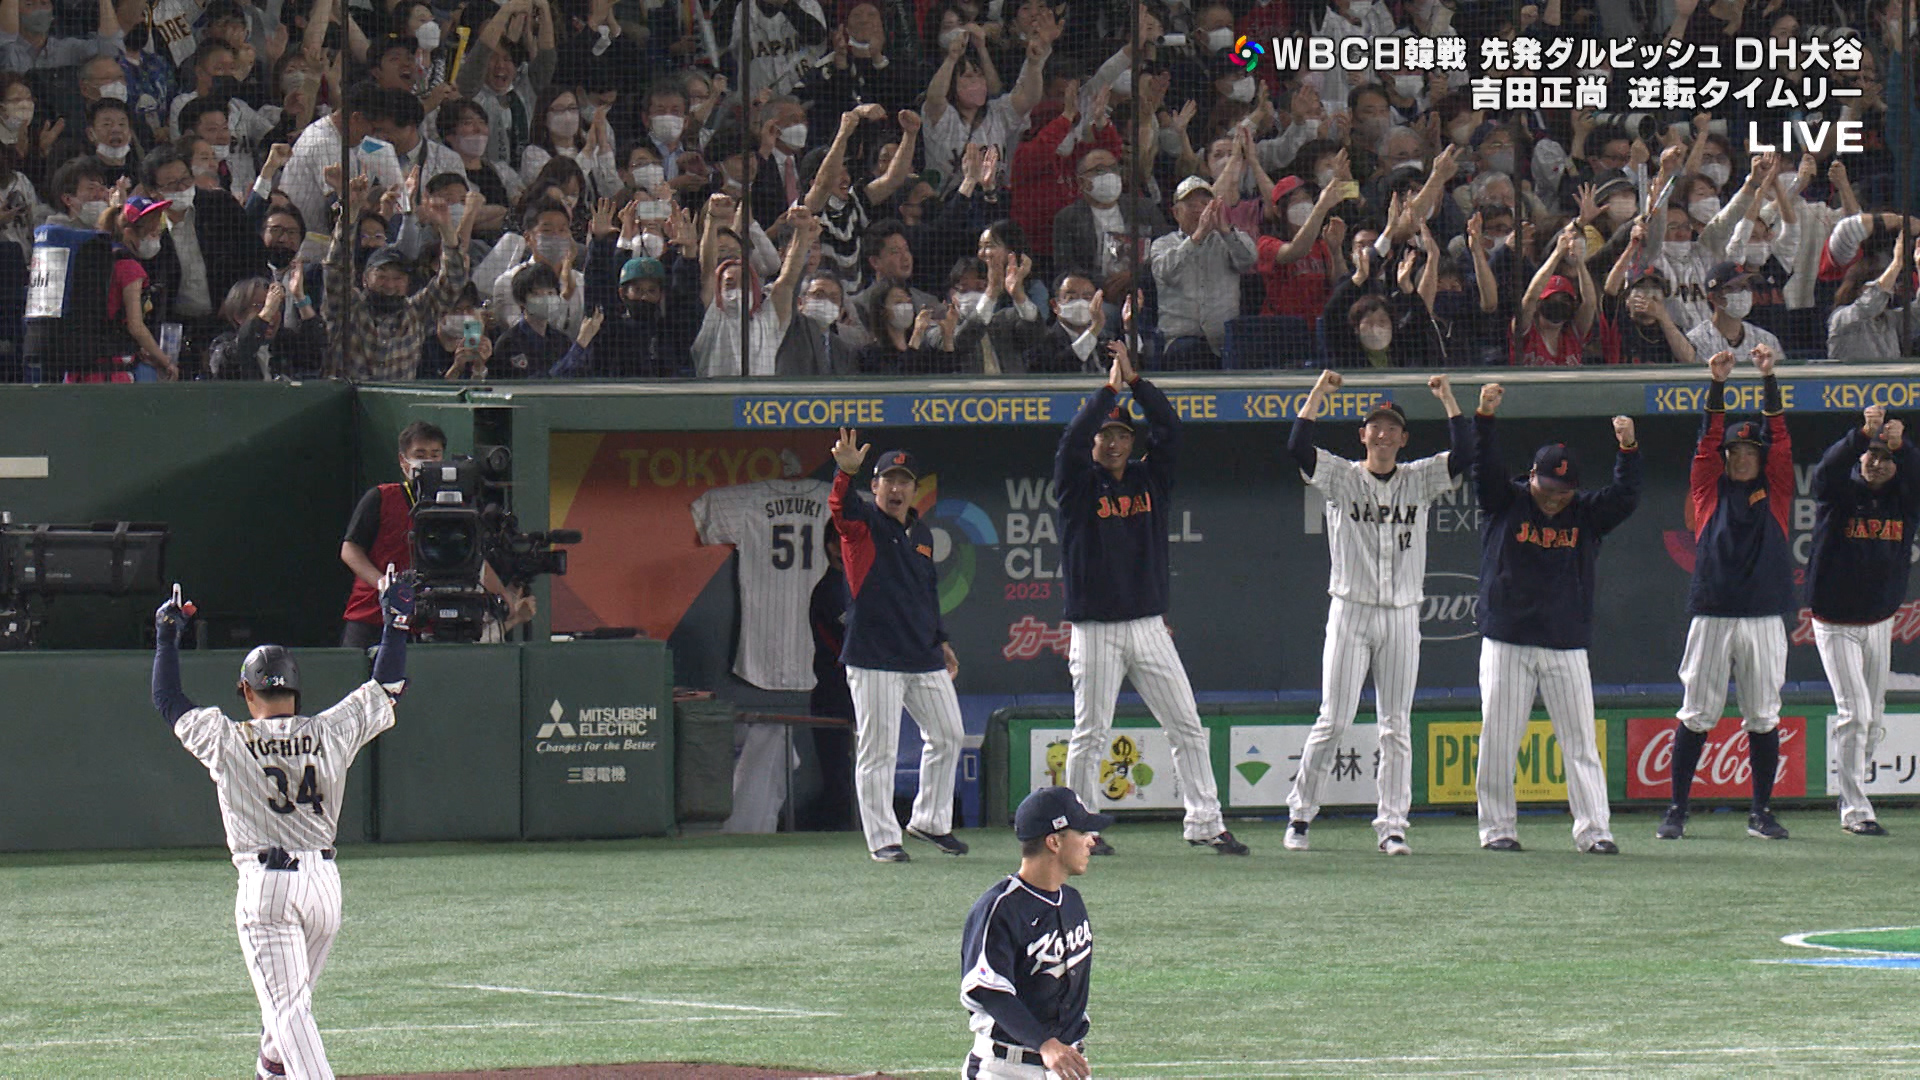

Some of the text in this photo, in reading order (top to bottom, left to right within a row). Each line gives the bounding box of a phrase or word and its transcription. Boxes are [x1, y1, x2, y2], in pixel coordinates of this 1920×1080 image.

[619, 448, 782, 488] TOKYO
[765, 499, 822, 518] SUZUKI
[771, 524, 814, 571] 51
[1005, 583, 1051, 600] 2023
[273, 676, 285, 686] 34
[580, 707, 657, 722] MITSUBISHI
[580, 721, 648, 736] ELECTRIC
[536, 739, 656, 754] Changes for the Better
[263, 764, 324, 815] 34
[1027, 919, 1093, 966] Korea
